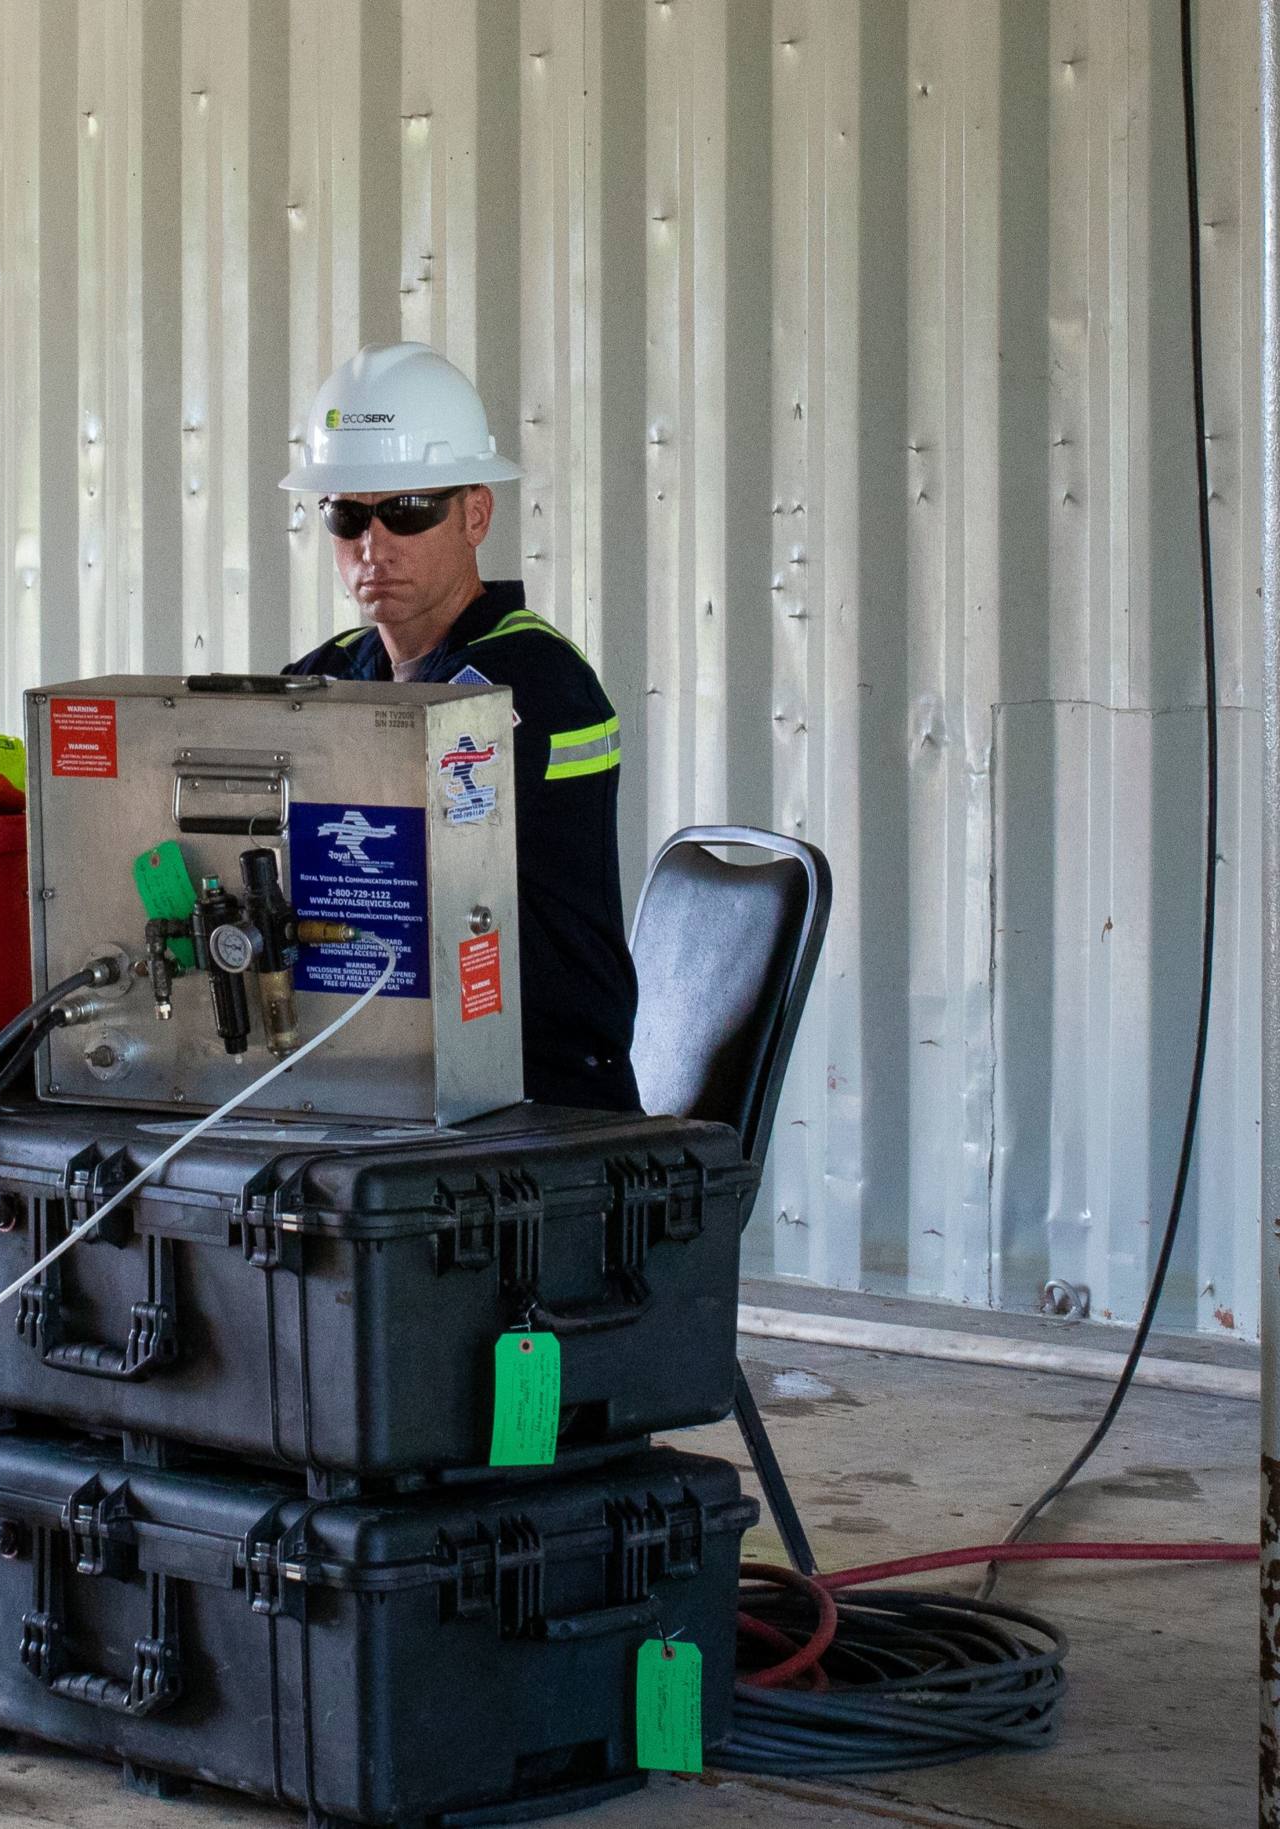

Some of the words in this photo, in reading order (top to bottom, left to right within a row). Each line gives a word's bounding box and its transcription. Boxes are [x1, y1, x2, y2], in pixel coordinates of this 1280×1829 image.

[343, 414, 395, 424] ecoSERV
[328, 850, 351, 862] Royal
[345, 876, 392, 885] COMMUNICATION
[328, 888, 391, 899] 1-800-729-1122
[310, 897, 410, 909] WWW.ROYALSERVICES.COM
[346, 912, 393, 921] COMMUNICATION
[394, 914, 423, 922] PRODUCTS
[354, 950, 377, 958] ACCESS
[307, 966, 341, 974] ENCLOSURE
[343, 968, 368, 976] SHOULD
[346, 962, 377, 970] WARNING
